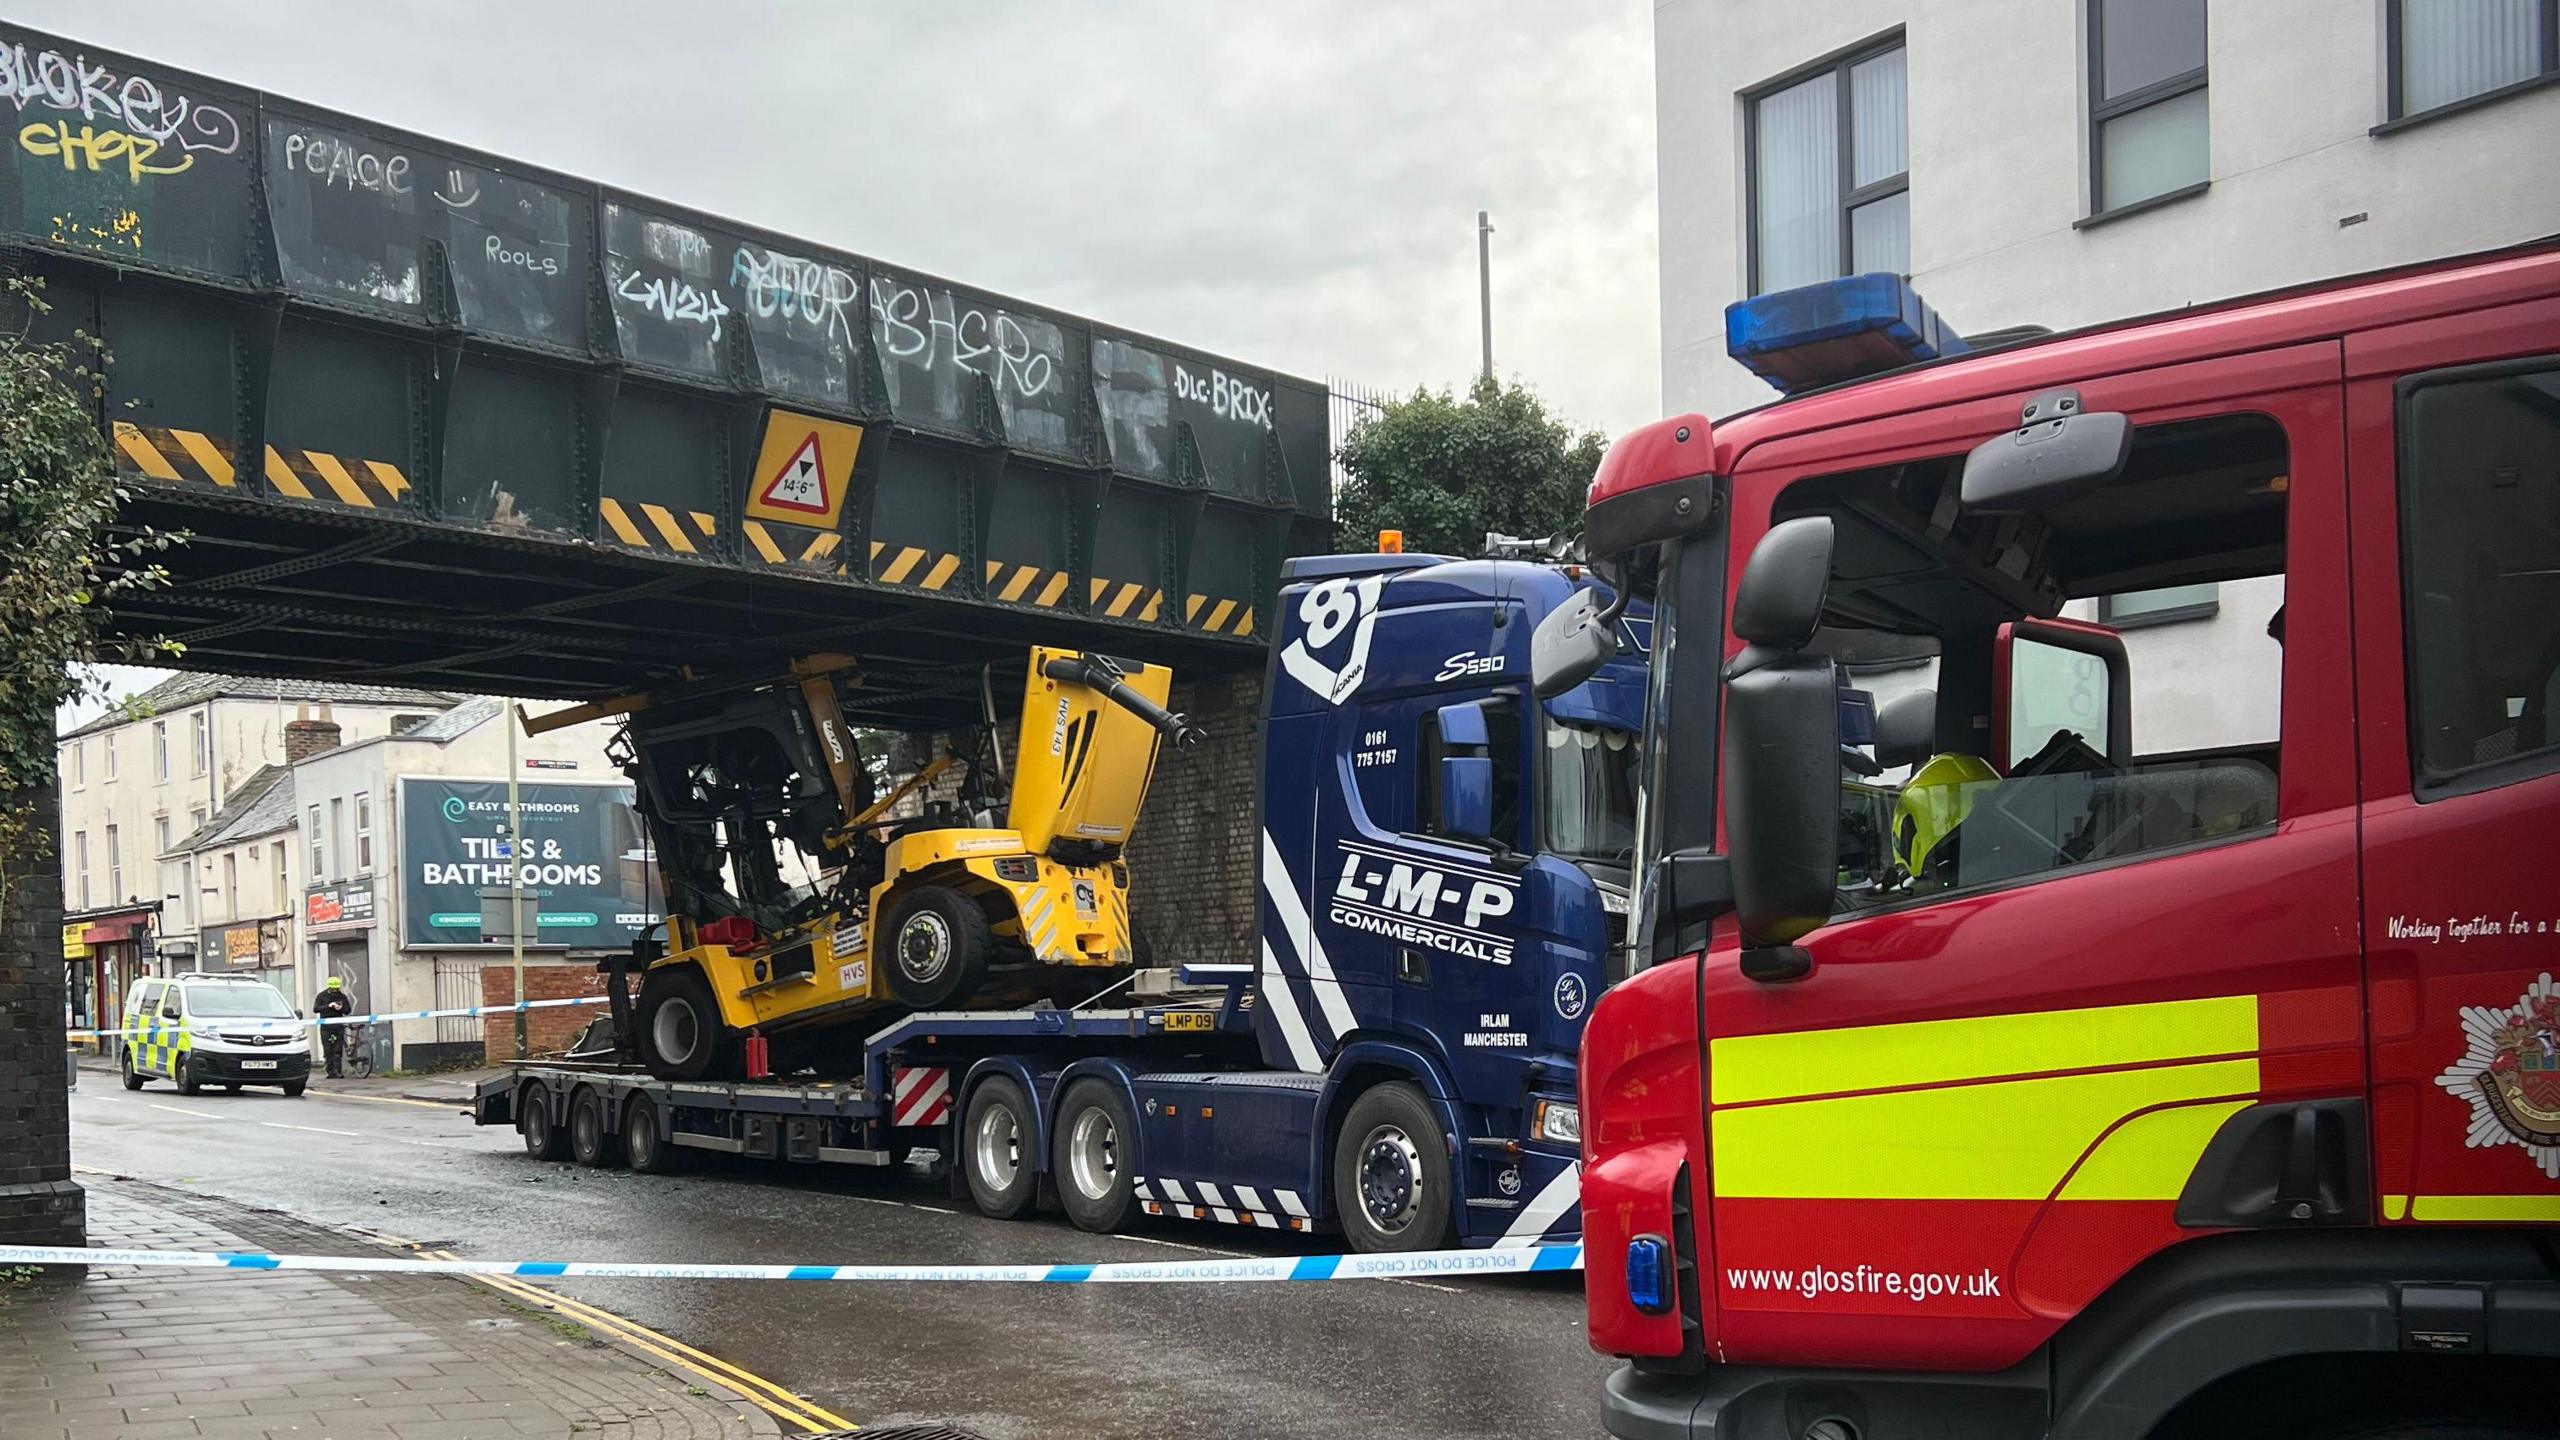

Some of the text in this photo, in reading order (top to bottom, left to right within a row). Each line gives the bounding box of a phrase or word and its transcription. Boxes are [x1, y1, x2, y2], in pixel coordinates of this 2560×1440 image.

[1434, 651, 1505, 682] S590
[1057, 698, 1068, 726] HVS
[1365, 730, 1387, 746] 0161
[1357, 749, 1397, 767] 775 7157
[468, 801, 499, 812] EASY
[461, 837, 562, 860] TILS &
[2388, 915, 2441, 944] Working
[2448, 915, 2502, 943] together
[2508, 911, 2530, 934] for
[2537, 921, 2547, 933] a
[1330, 908, 1513, 966] COMMERCIALS
[843, 964, 865, 982] HVS
[1167, 1014, 1211, 1028] LMP 09
[1480, 1014, 1510, 1028] IRLAM
[1463, 1033, 1528, 1047] MANCHESTER
[1357, 1255, 1516, 1272] POLICE DO NOT CROSS
[1727, 1264, 2001, 1301] www.glosfire.gov.uk
